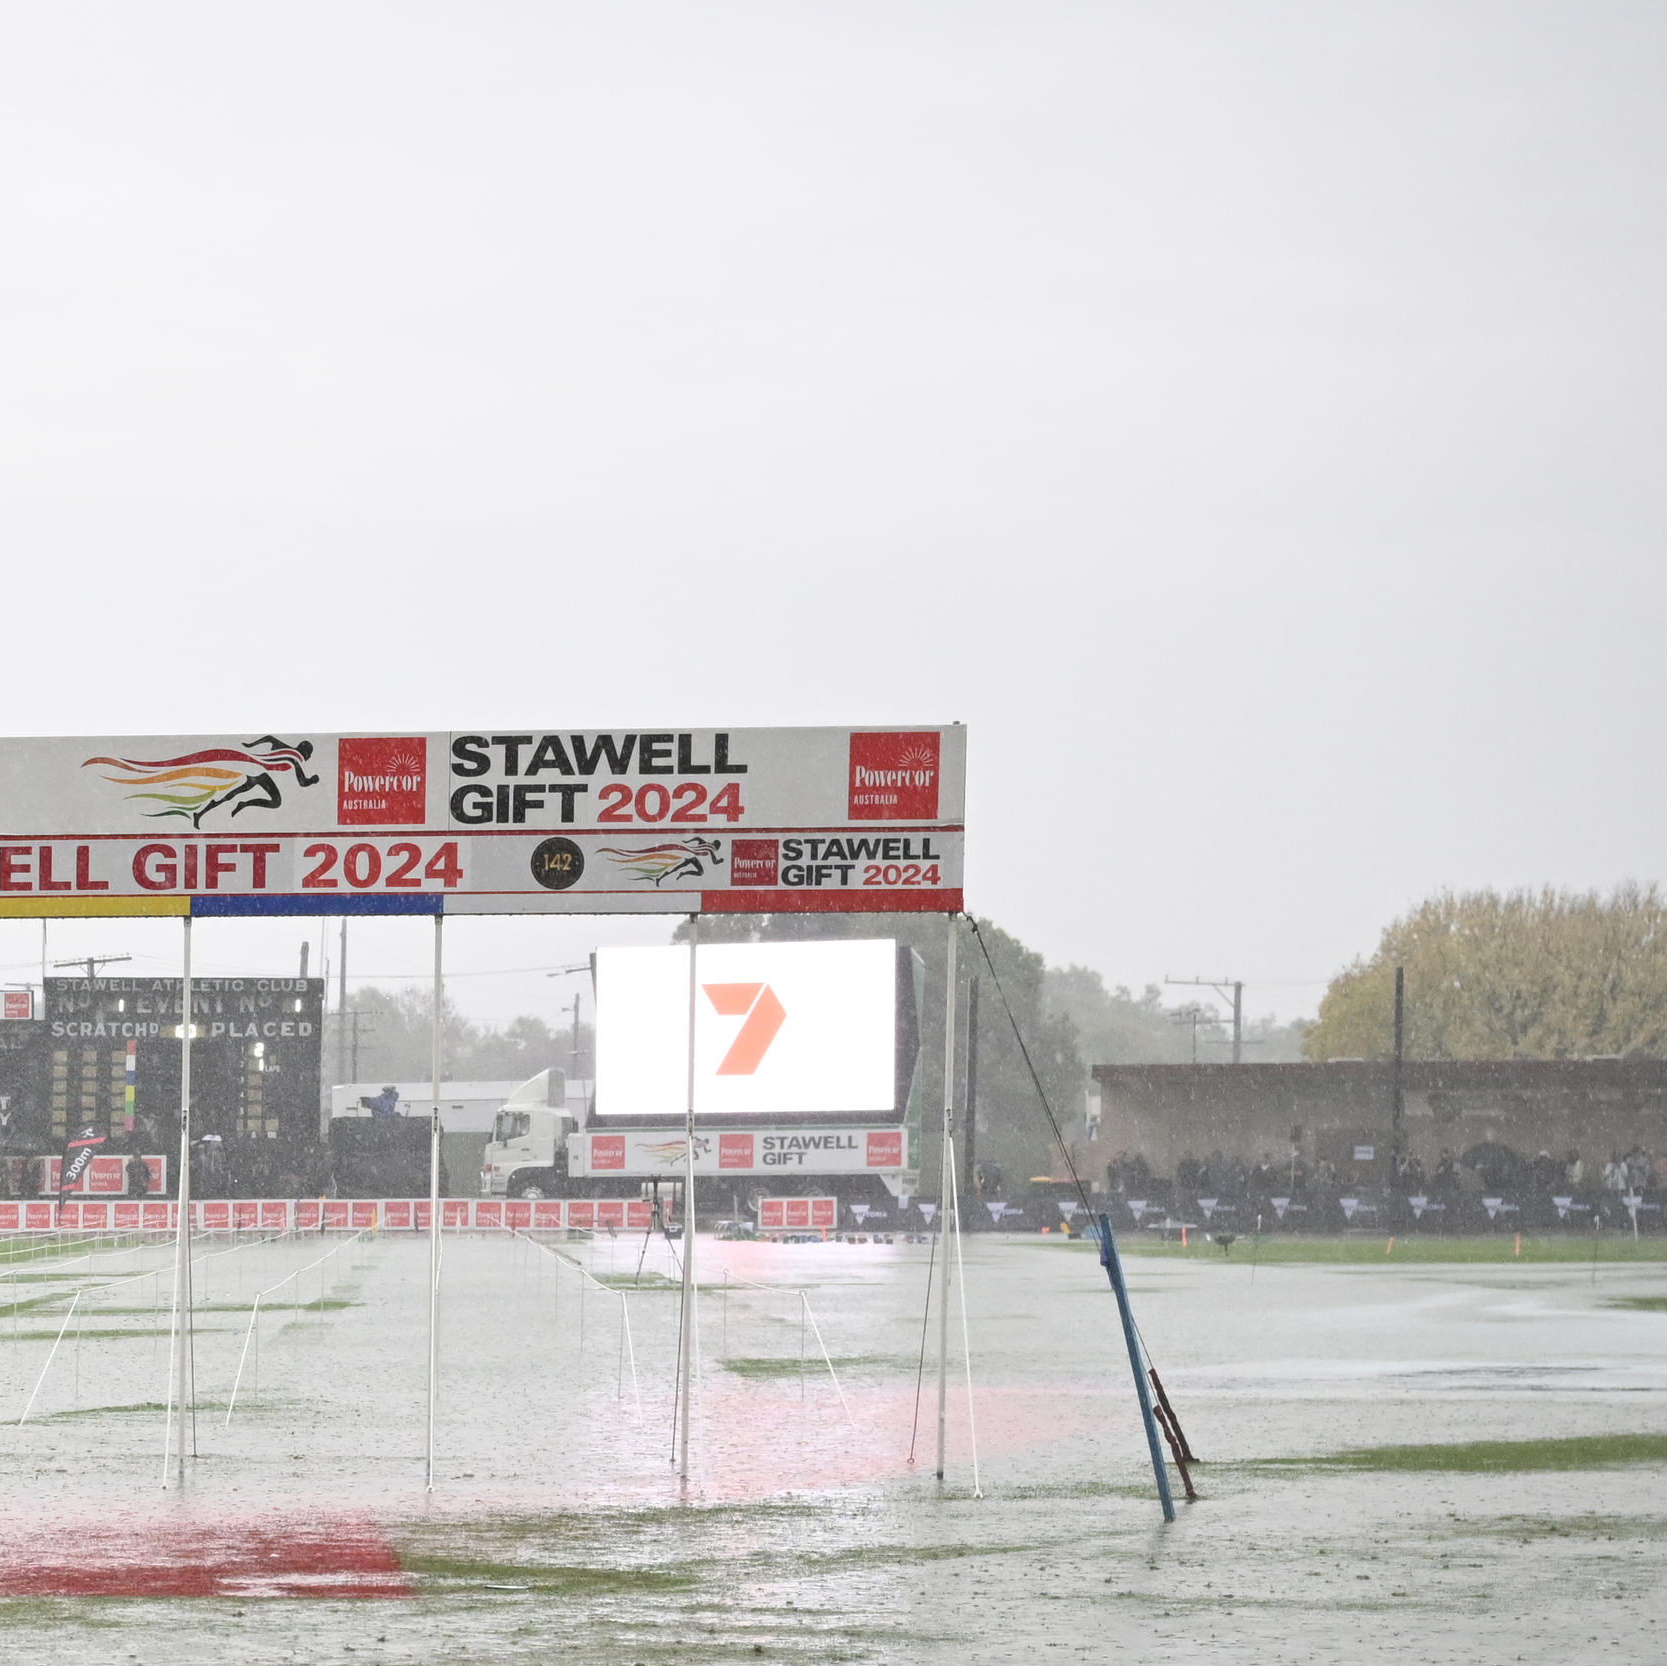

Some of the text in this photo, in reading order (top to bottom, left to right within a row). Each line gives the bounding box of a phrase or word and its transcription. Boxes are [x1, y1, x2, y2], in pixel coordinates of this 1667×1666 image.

[450, 733, 748, 779] STAWELL
[343, 771, 421, 793] Powercor
[854, 765, 934, 788] Powercor
[342, 800, 386, 810] AUSTRALIA
[449, 782, 745, 825] GIFT 2024
[853, 794, 898, 805] AUSTRALIA
[781, 838, 941, 862] STAWELL
[131, 842, 280, 891] GIFT
[301, 841, 464, 889] 2024
[543, 853, 572, 872] 142
[733, 856, 776, 871] Powercor
[781, 863, 941, 887] GIFT 2024
[56, 978, 309, 992] STAWELL ATHLETIC CLUB
[136, 997, 223, 1013] EVENT
[210, 1021, 313, 1037] PLACED
[762, 1135, 859, 1151] STAWELL
[66, 1147, 92, 1180] 300m
[762, 1151, 807, 1166] GIFT
